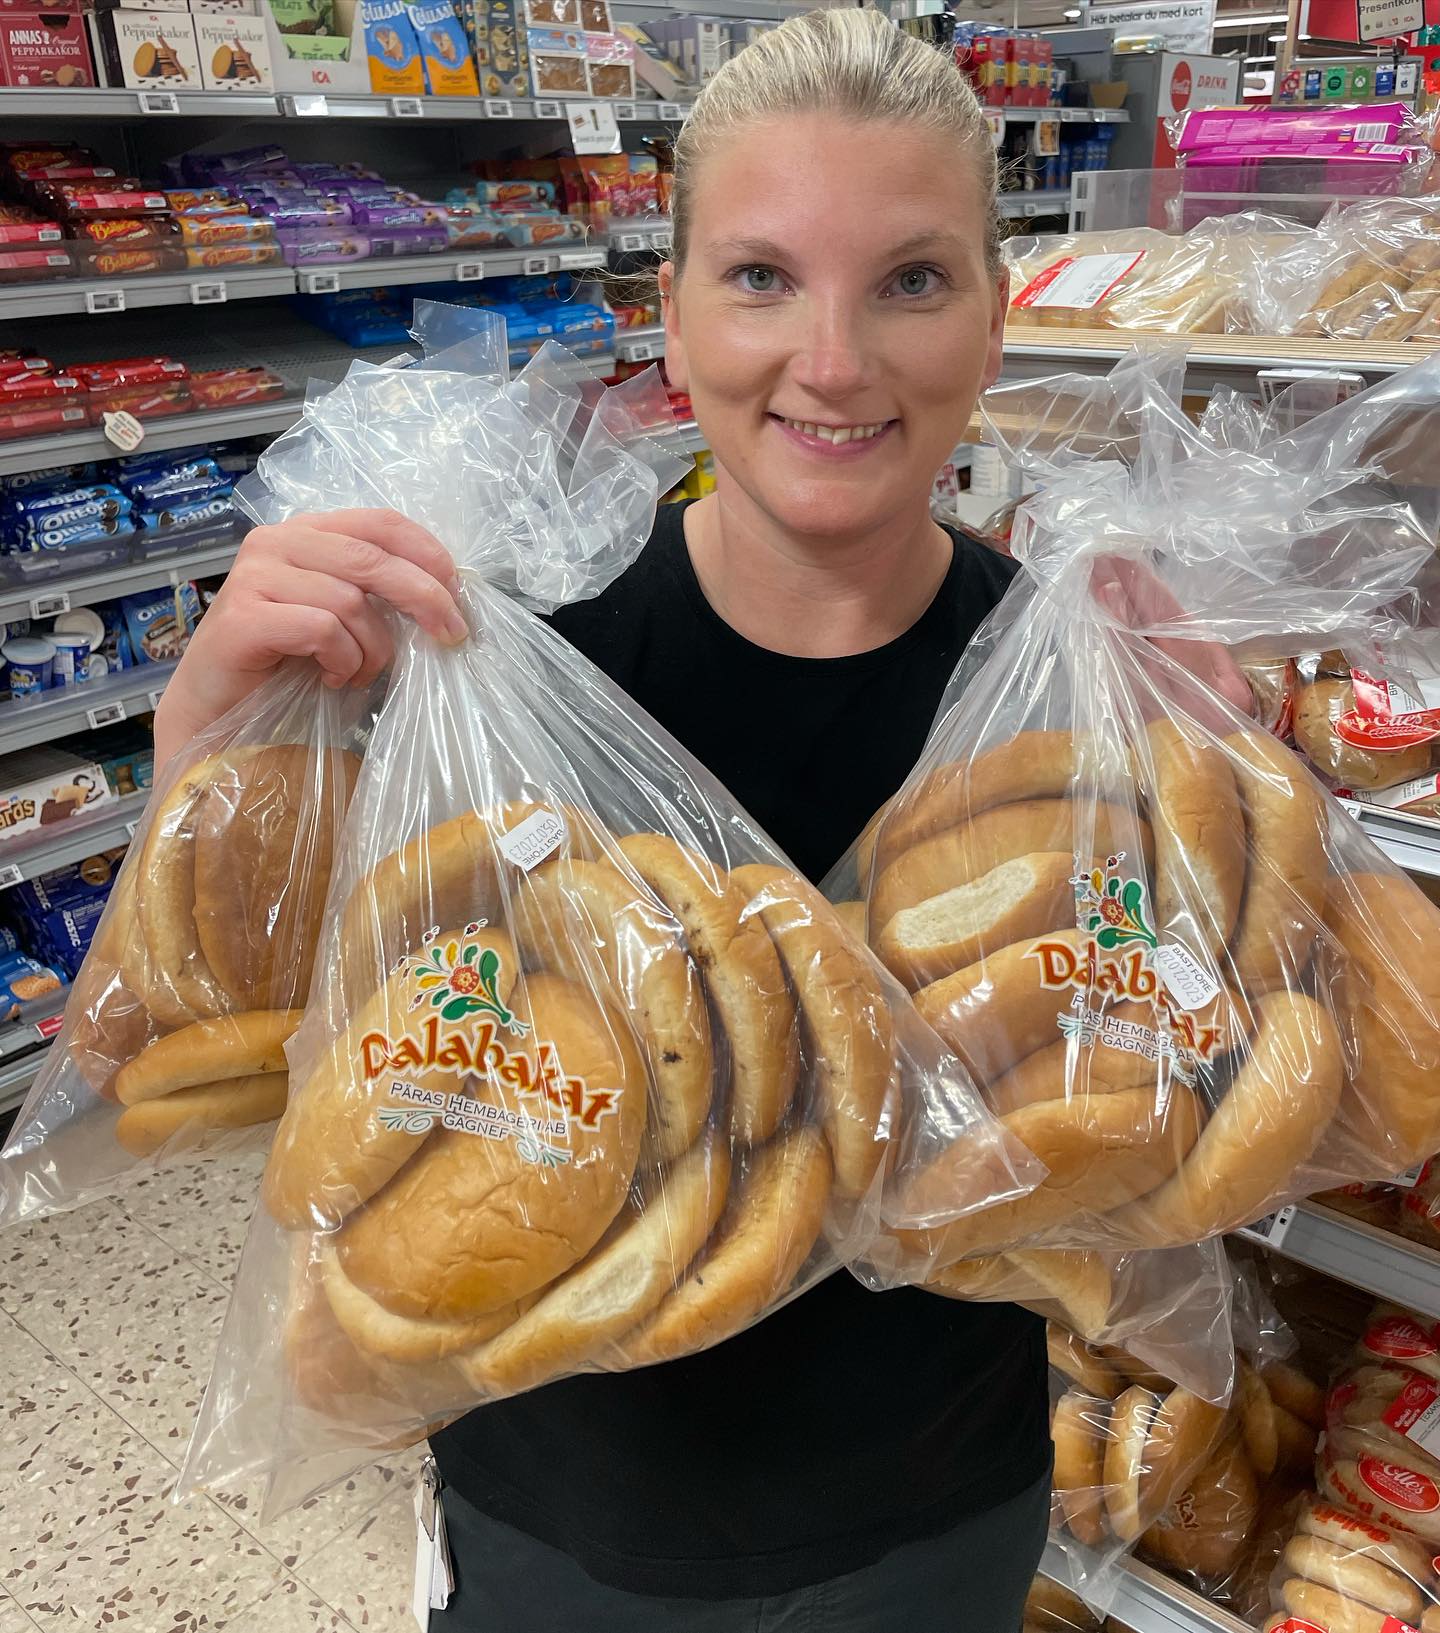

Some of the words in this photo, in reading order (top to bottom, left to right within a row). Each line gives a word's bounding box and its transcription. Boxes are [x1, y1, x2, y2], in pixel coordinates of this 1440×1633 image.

[1109, 12, 1142, 23] betalar
[1146, 10, 1158, 19] du
[1159, 9, 1181, 19] med
[1183, 7, 1204, 16] kort
[9, 30, 42, 45] ANNAS
[122, 25, 190, 41] Pepparkakor
[202, 27, 263, 43] Pepparkakor
[11, 47, 81, 56] PEPPARKAKOR
[312, 70, 332, 84] ICA
[1197, 75, 1228, 90] DRINK
[1102, 1033, 1160, 1060] GAGNEF
[359, 1019, 622, 1128] Dalabakar
[390, 1081, 443, 1106] PÄRAS
[445, 1094, 543, 1131] HEMBAGERI
[545, 1119, 567, 1135] AB
[443, 1113, 510, 1139] GAGNEF
